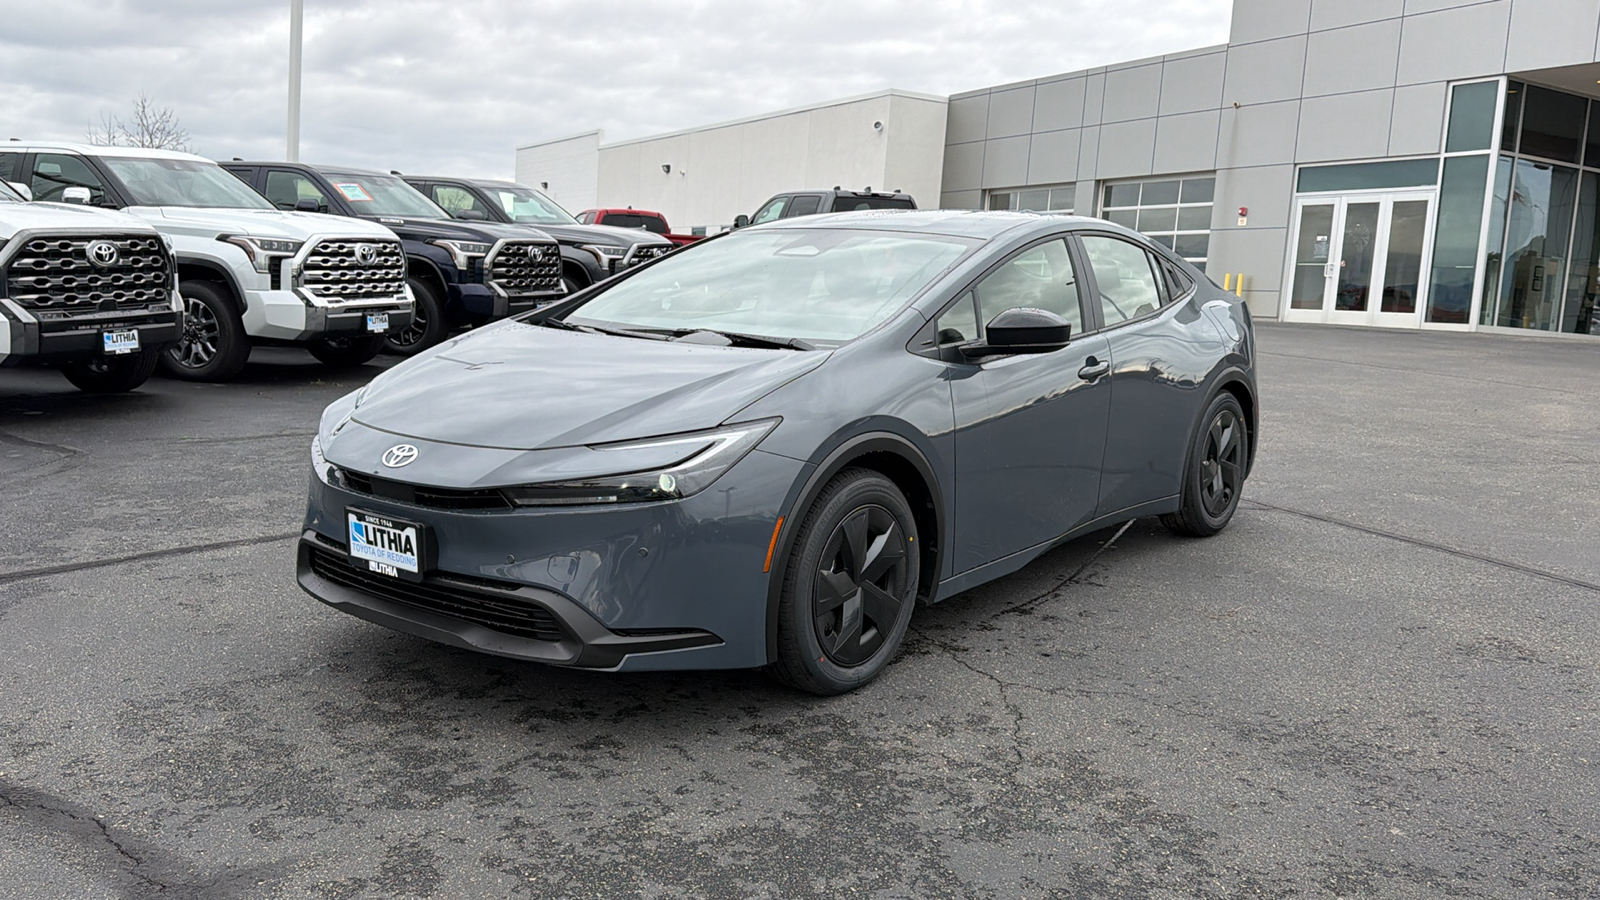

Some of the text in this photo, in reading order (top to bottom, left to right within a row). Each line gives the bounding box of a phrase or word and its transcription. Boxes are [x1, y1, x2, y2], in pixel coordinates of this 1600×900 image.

[111, 332, 137, 344] LITHIA
[365, 515, 380, 525] SINCE
[364, 525, 415, 557] LITHIA
[801, 496, 844, 573] BRIDGESTONE
[352, 542, 416, 567] TOYOTA OF REDDING
[375, 562, 399, 578] LITHIA
